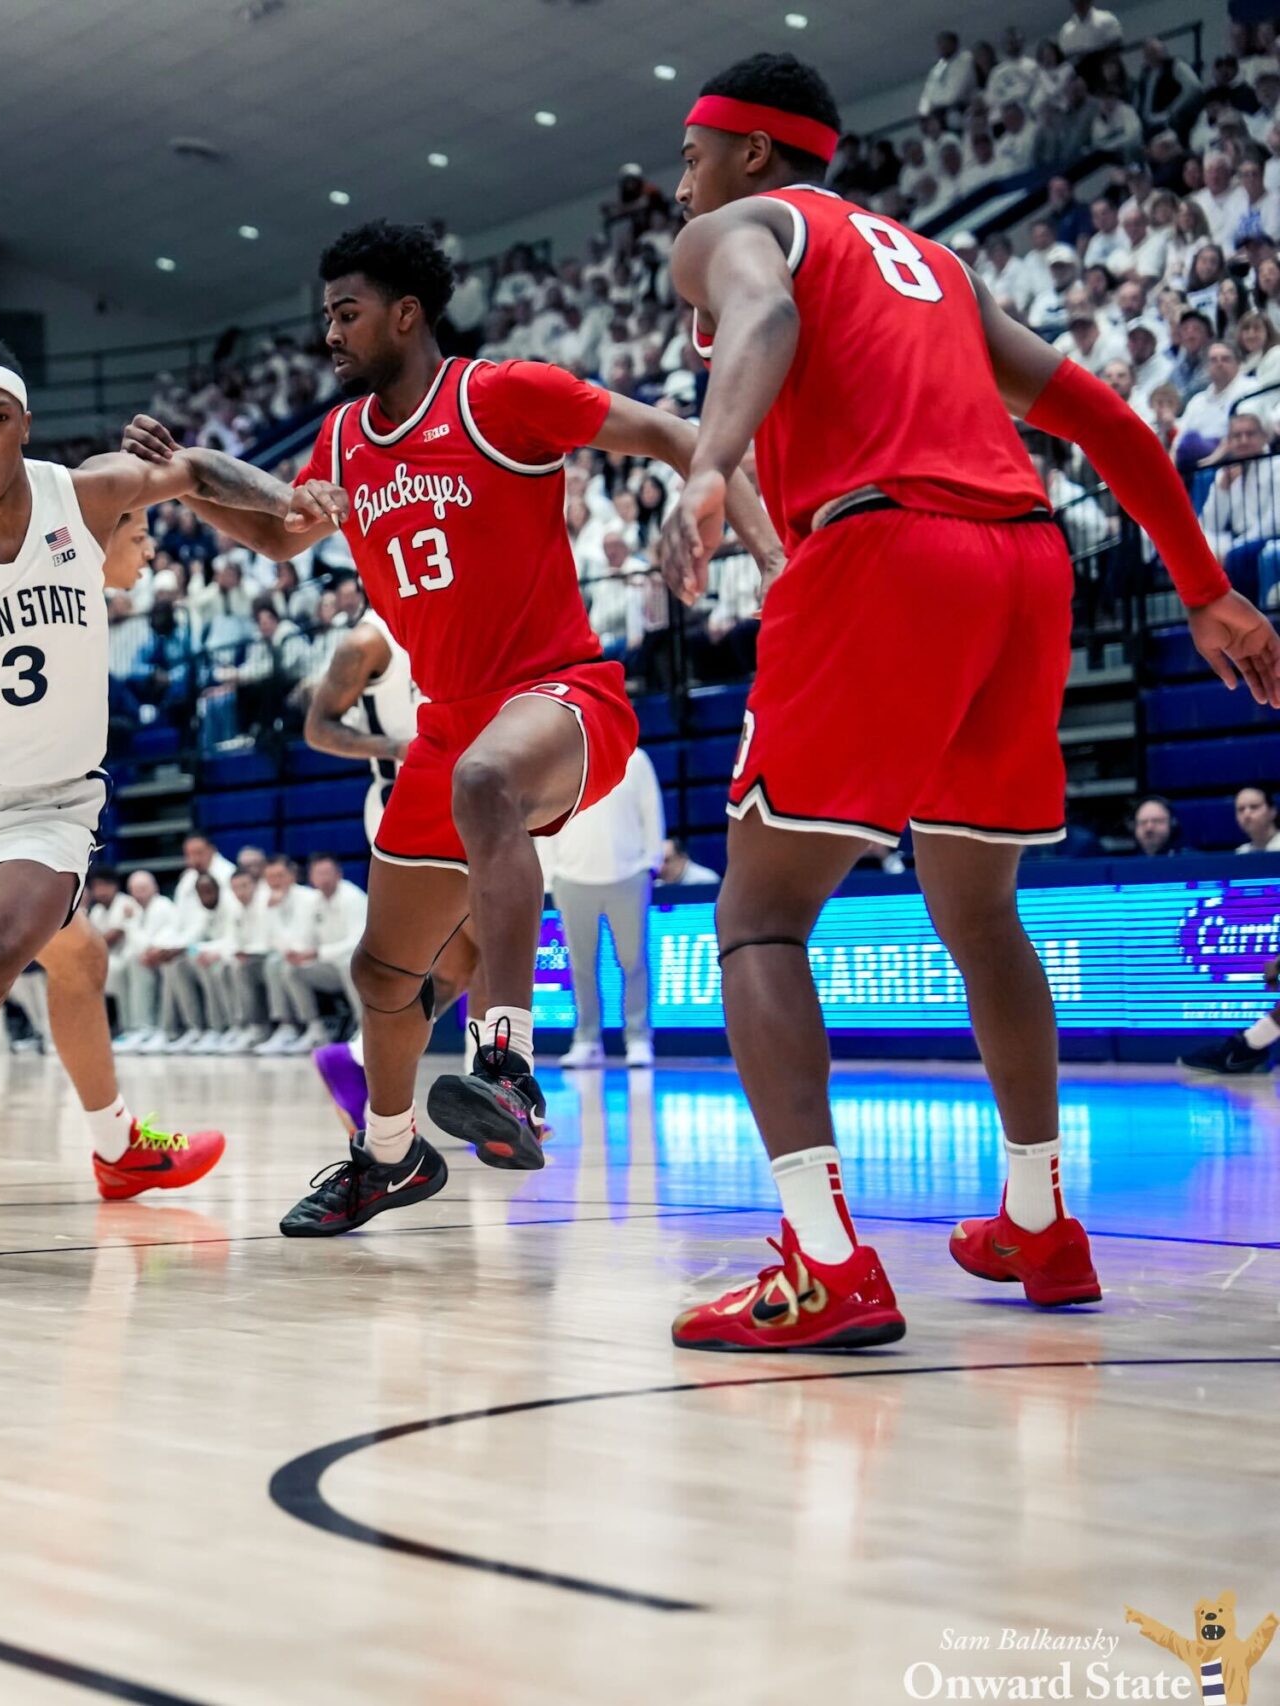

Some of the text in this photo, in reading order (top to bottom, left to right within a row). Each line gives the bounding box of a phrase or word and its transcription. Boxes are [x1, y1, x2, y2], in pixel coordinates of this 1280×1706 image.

[848, 212, 944, 303] 8
[353, 462, 472, 538] Buckeyes
[386, 527, 455, 599] 13
[16, 585, 88, 628] STATE
[1, 645, 49, 707] 3
